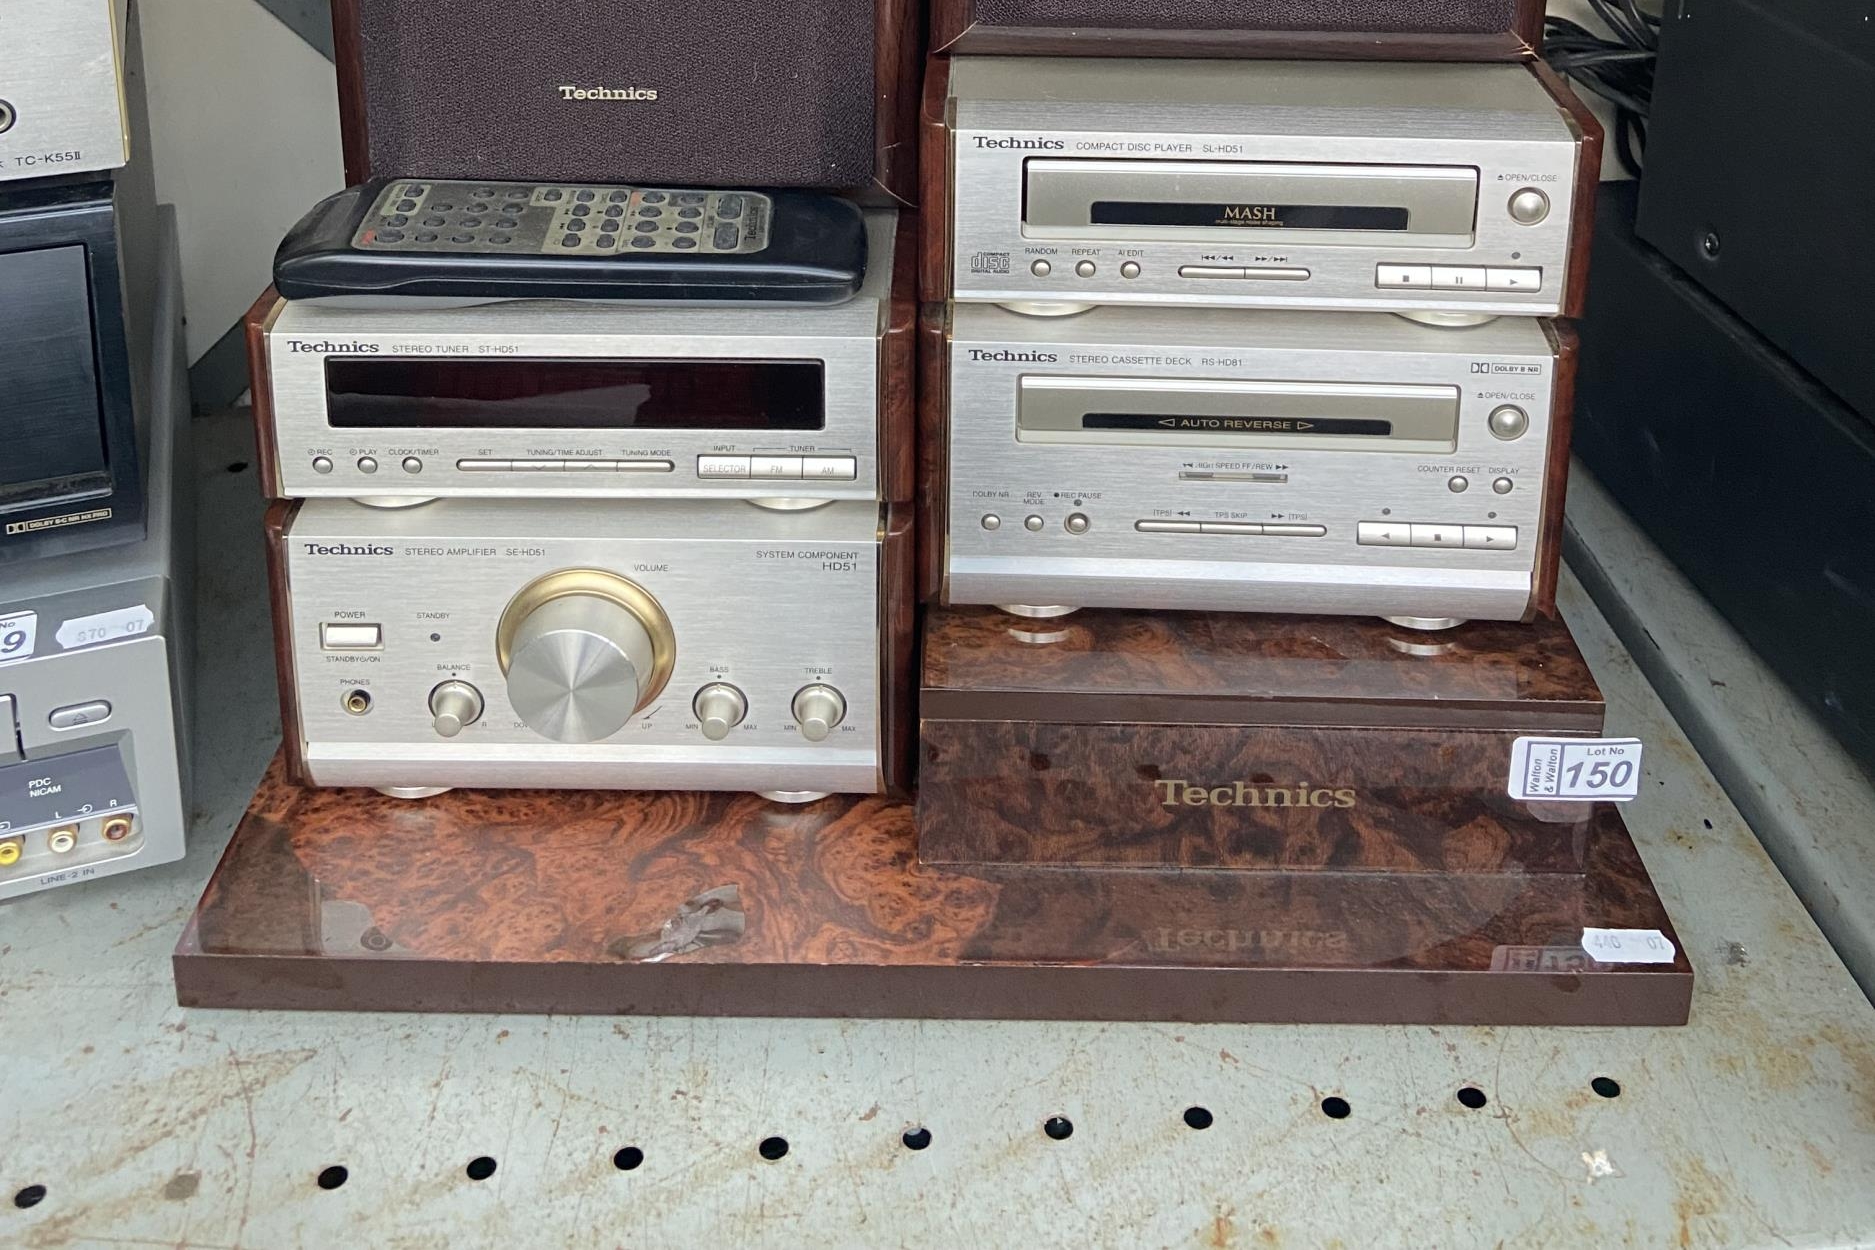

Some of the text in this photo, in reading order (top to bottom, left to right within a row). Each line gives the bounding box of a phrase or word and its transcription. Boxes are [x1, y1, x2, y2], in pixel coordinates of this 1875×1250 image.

[559, 86, 658, 100] Technics
[973, 136, 1243, 153] Technics COMPACT DISC PLAYER SL-HD51
[1505, 173, 1557, 182] OPEN/CLOSE
[1224, 206, 1276, 220] MASH
[1025, 247, 1058, 255] RANDOM
[1071, 248, 1101, 256] REPEAT
[287, 341, 519, 354] Technics STEREO TUNER ST-HD51
[968, 349, 1058, 363] Technics
[1069, 355, 1109, 364] STEREO
[1111, 356, 1162, 365] CASSETTE
[1165, 357, 1192, 366] DECK
[1485, 392, 1536, 400] OPEN/CLOSE
[1180, 419, 1292, 429] AUTO REVERSE
[703, 464, 746, 474] SELECTOR
[770, 465, 783, 474] FM
[822, 466, 835, 475] AM
[1215, 462, 1240, 470] SPEED
[1418, 465, 1480, 474] COUNTER RESET
[1488, 466, 1520, 475] DISPLAY
[972, 490, 997, 498] DOLBY
[304, 544, 394, 556] Technics
[405, 548, 444, 556] STEREO
[446, 548, 497, 556] AMPLIFIER
[756, 551, 859, 560] SYSTEM COMPONENT
[634, 564, 669, 572] VOLUME
[822, 562, 857, 572] HD51
[334, 611, 366, 619] POWER
[805, 667, 833, 675] TREBLE
[1587, 747, 1625, 756] Lot No
[1545, 748, 1558, 783] Walton
[1529, 758, 1542, 792] Walton
[1566, 760, 1633, 789] 150
[28, 777, 51, 789] PDC
[29, 785, 62, 798] NICAM
[1154, 779, 1356, 808] Technics
[109, 799, 118, 807] R
[55, 811, 62, 819] L
